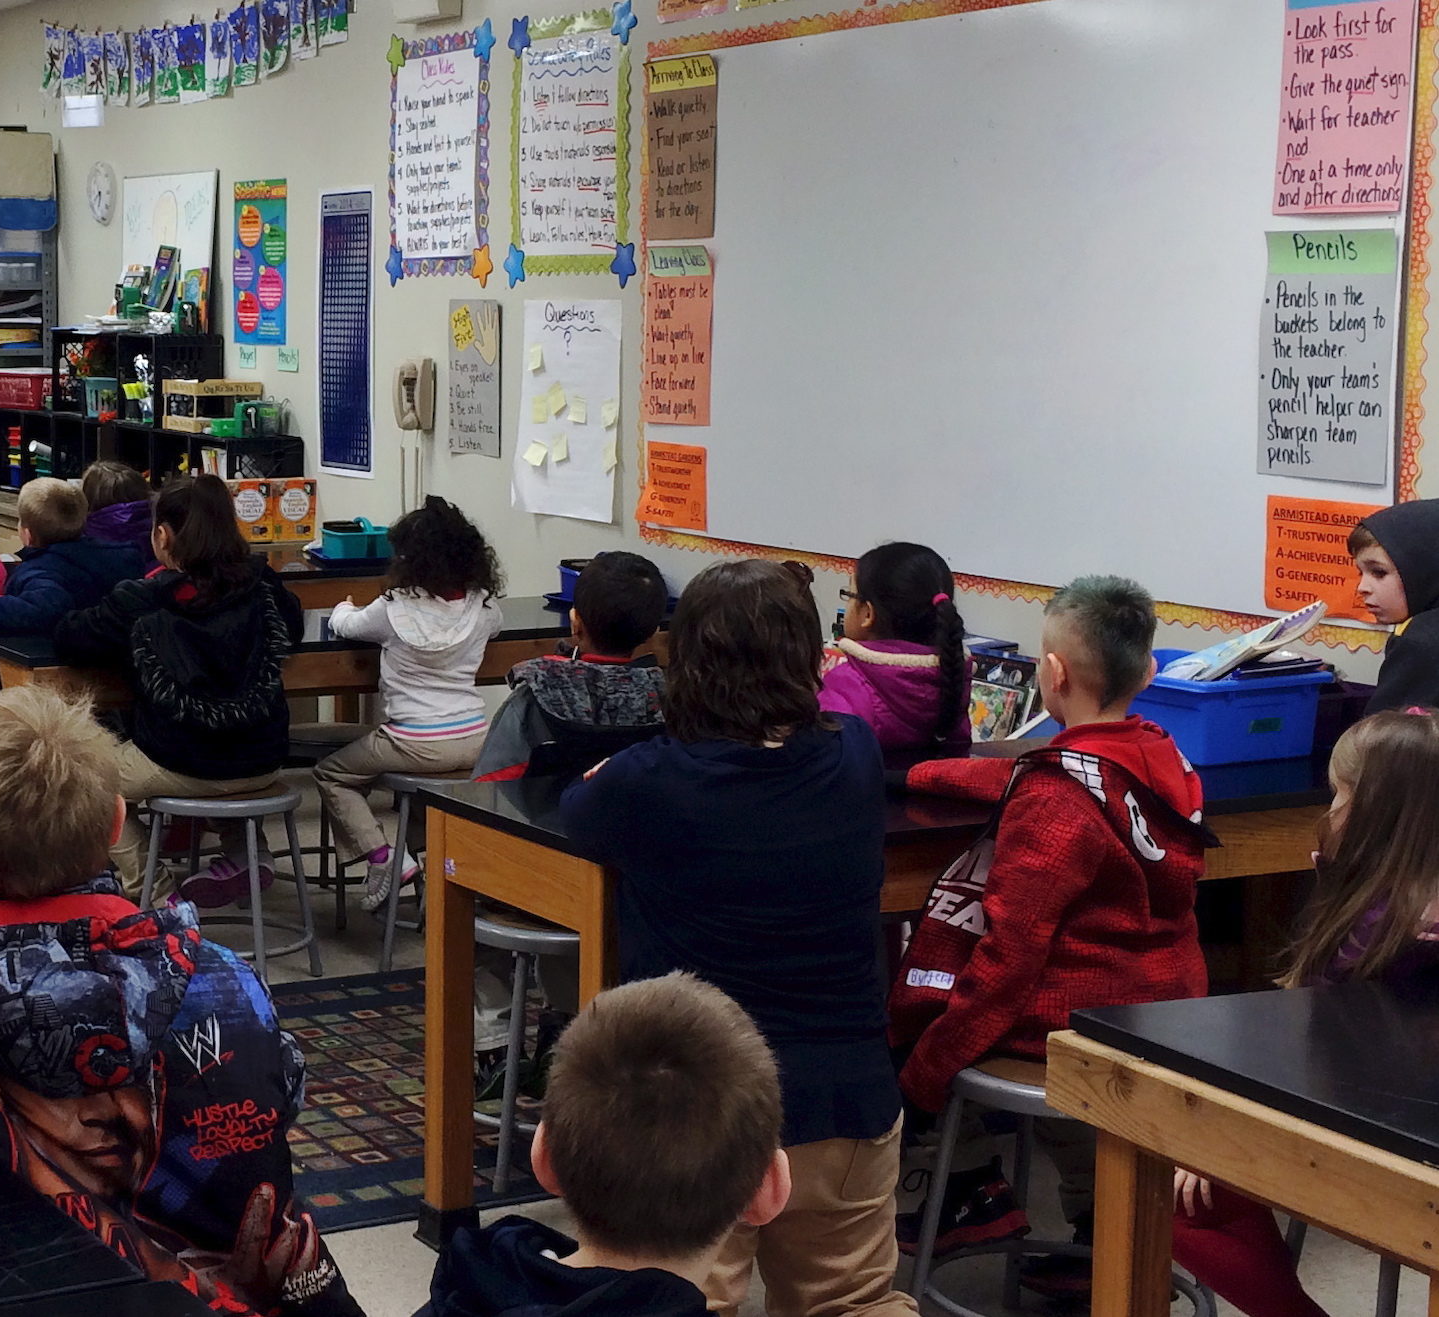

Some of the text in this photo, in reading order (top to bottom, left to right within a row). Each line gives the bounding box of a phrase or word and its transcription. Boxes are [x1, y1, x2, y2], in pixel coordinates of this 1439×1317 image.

[1295, 7, 1397, 40] Look first for
[1294, 43, 1359, 68] the pass.
[650, 59, 714, 86] Arriving to Class
[1290, 72, 1315, 99] Give
[1321, 73, 1342, 95] the
[1345, 66, 1379, 104] quiet
[653, 98, 677, 119] Walk
[1288, 104, 1400, 134] Wait for teacher
[656, 127, 674, 149] Find
[677, 131, 693, 152] your
[656, 152, 710, 177] Read or listen
[1282, 154, 1403, 186] One at a time only
[655, 178, 702, 197] to directions
[1278, 181, 1400, 207] and after directions
[655, 200, 680, 218] for the
[1293, 232, 1358, 261] Pencils
[651, 248, 706, 276] Leaving Class
[652, 282, 708, 299] Tables must be
[1276, 280, 1365, 309] Pencils in the
[544, 302, 595, 323] Questions
[1274, 306, 1386, 343] buckets belong to
[563, 330, 572, 356] ?
[650, 323, 693, 350] Wait quietly
[1272, 335, 1347, 359] the teacher.
[455, 359, 478, 375] Eyes on
[651, 346, 705, 371] Line up on line
[455, 384, 475, 399] Quiet
[651, 371, 695, 391] Face forward
[1271, 362, 1380, 398] Only your team's
[649, 395, 696, 421] Stand quietly
[1268, 391, 1382, 423] pencil helper can
[1267, 418, 1357, 448] sharpen team
[1273, 508, 1329, 523] ARMISTEAD
[1275, 566, 1346, 587] G-GENEROSITY
[1275, 587, 1318, 603] S-SAFETY
